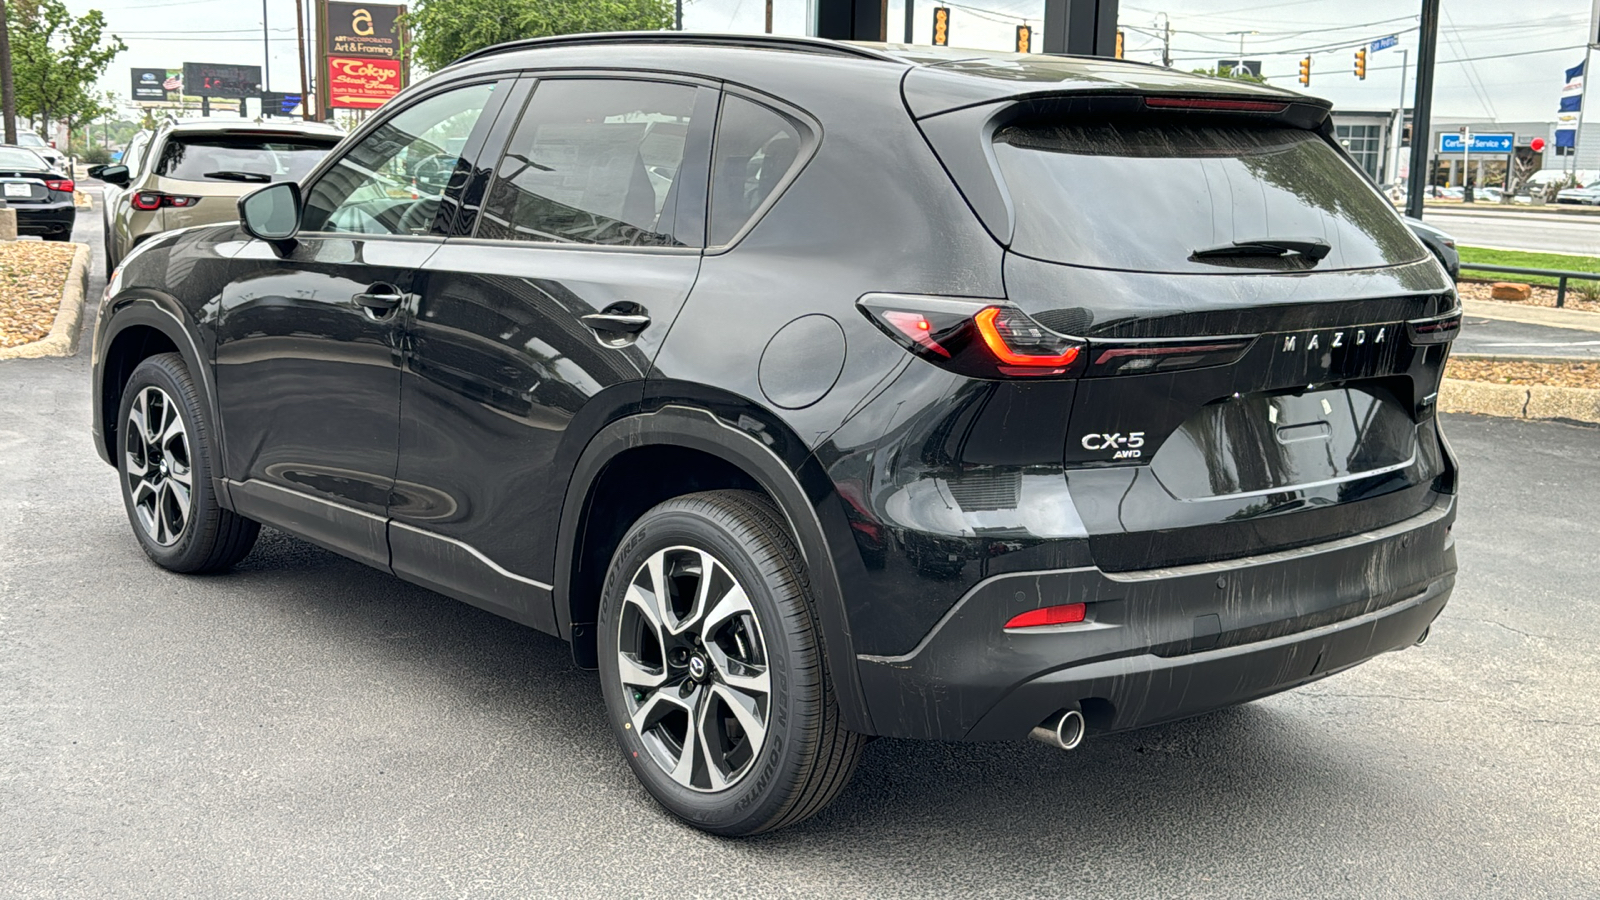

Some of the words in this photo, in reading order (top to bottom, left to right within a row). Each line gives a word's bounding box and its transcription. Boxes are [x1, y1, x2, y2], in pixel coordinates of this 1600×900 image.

[334, 43, 349, 51] Art
[349, 43, 357, 53] &
[357, 43, 394, 56] Framing
[332, 59, 397, 82] Tokyo
[1475, 138, 1499, 148] Service
[1282, 328, 1386, 352] MAZDA
[1081, 432, 1145, 450] CX-5
[1112, 449, 1142, 459] AWD
[615, 527, 647, 571] TIRES
[775, 653, 788, 728] OPEN
[732, 735, 783, 817] COUNTRY
